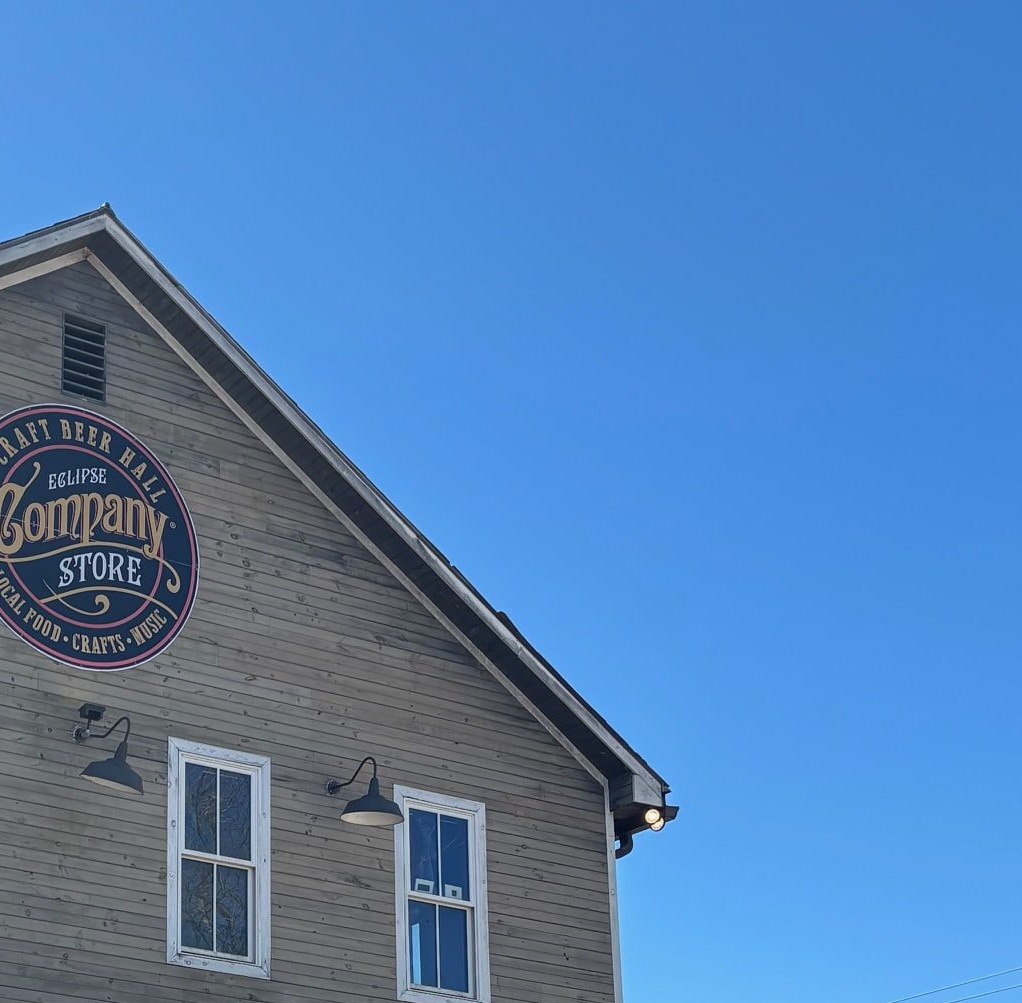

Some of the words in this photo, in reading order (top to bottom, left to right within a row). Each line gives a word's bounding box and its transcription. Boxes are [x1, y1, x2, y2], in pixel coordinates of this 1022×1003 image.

[48, 467, 107, 490] ECLIPSE
[59, 419, 112, 454] BEER
[118, 446, 167, 504] HALL
[57, 552, 142, 588] STORE
[23, 607, 62, 643] FOOD
[72, 632, 127, 655] CRAFTS
[130, 608, 168, 646] MUSIC
